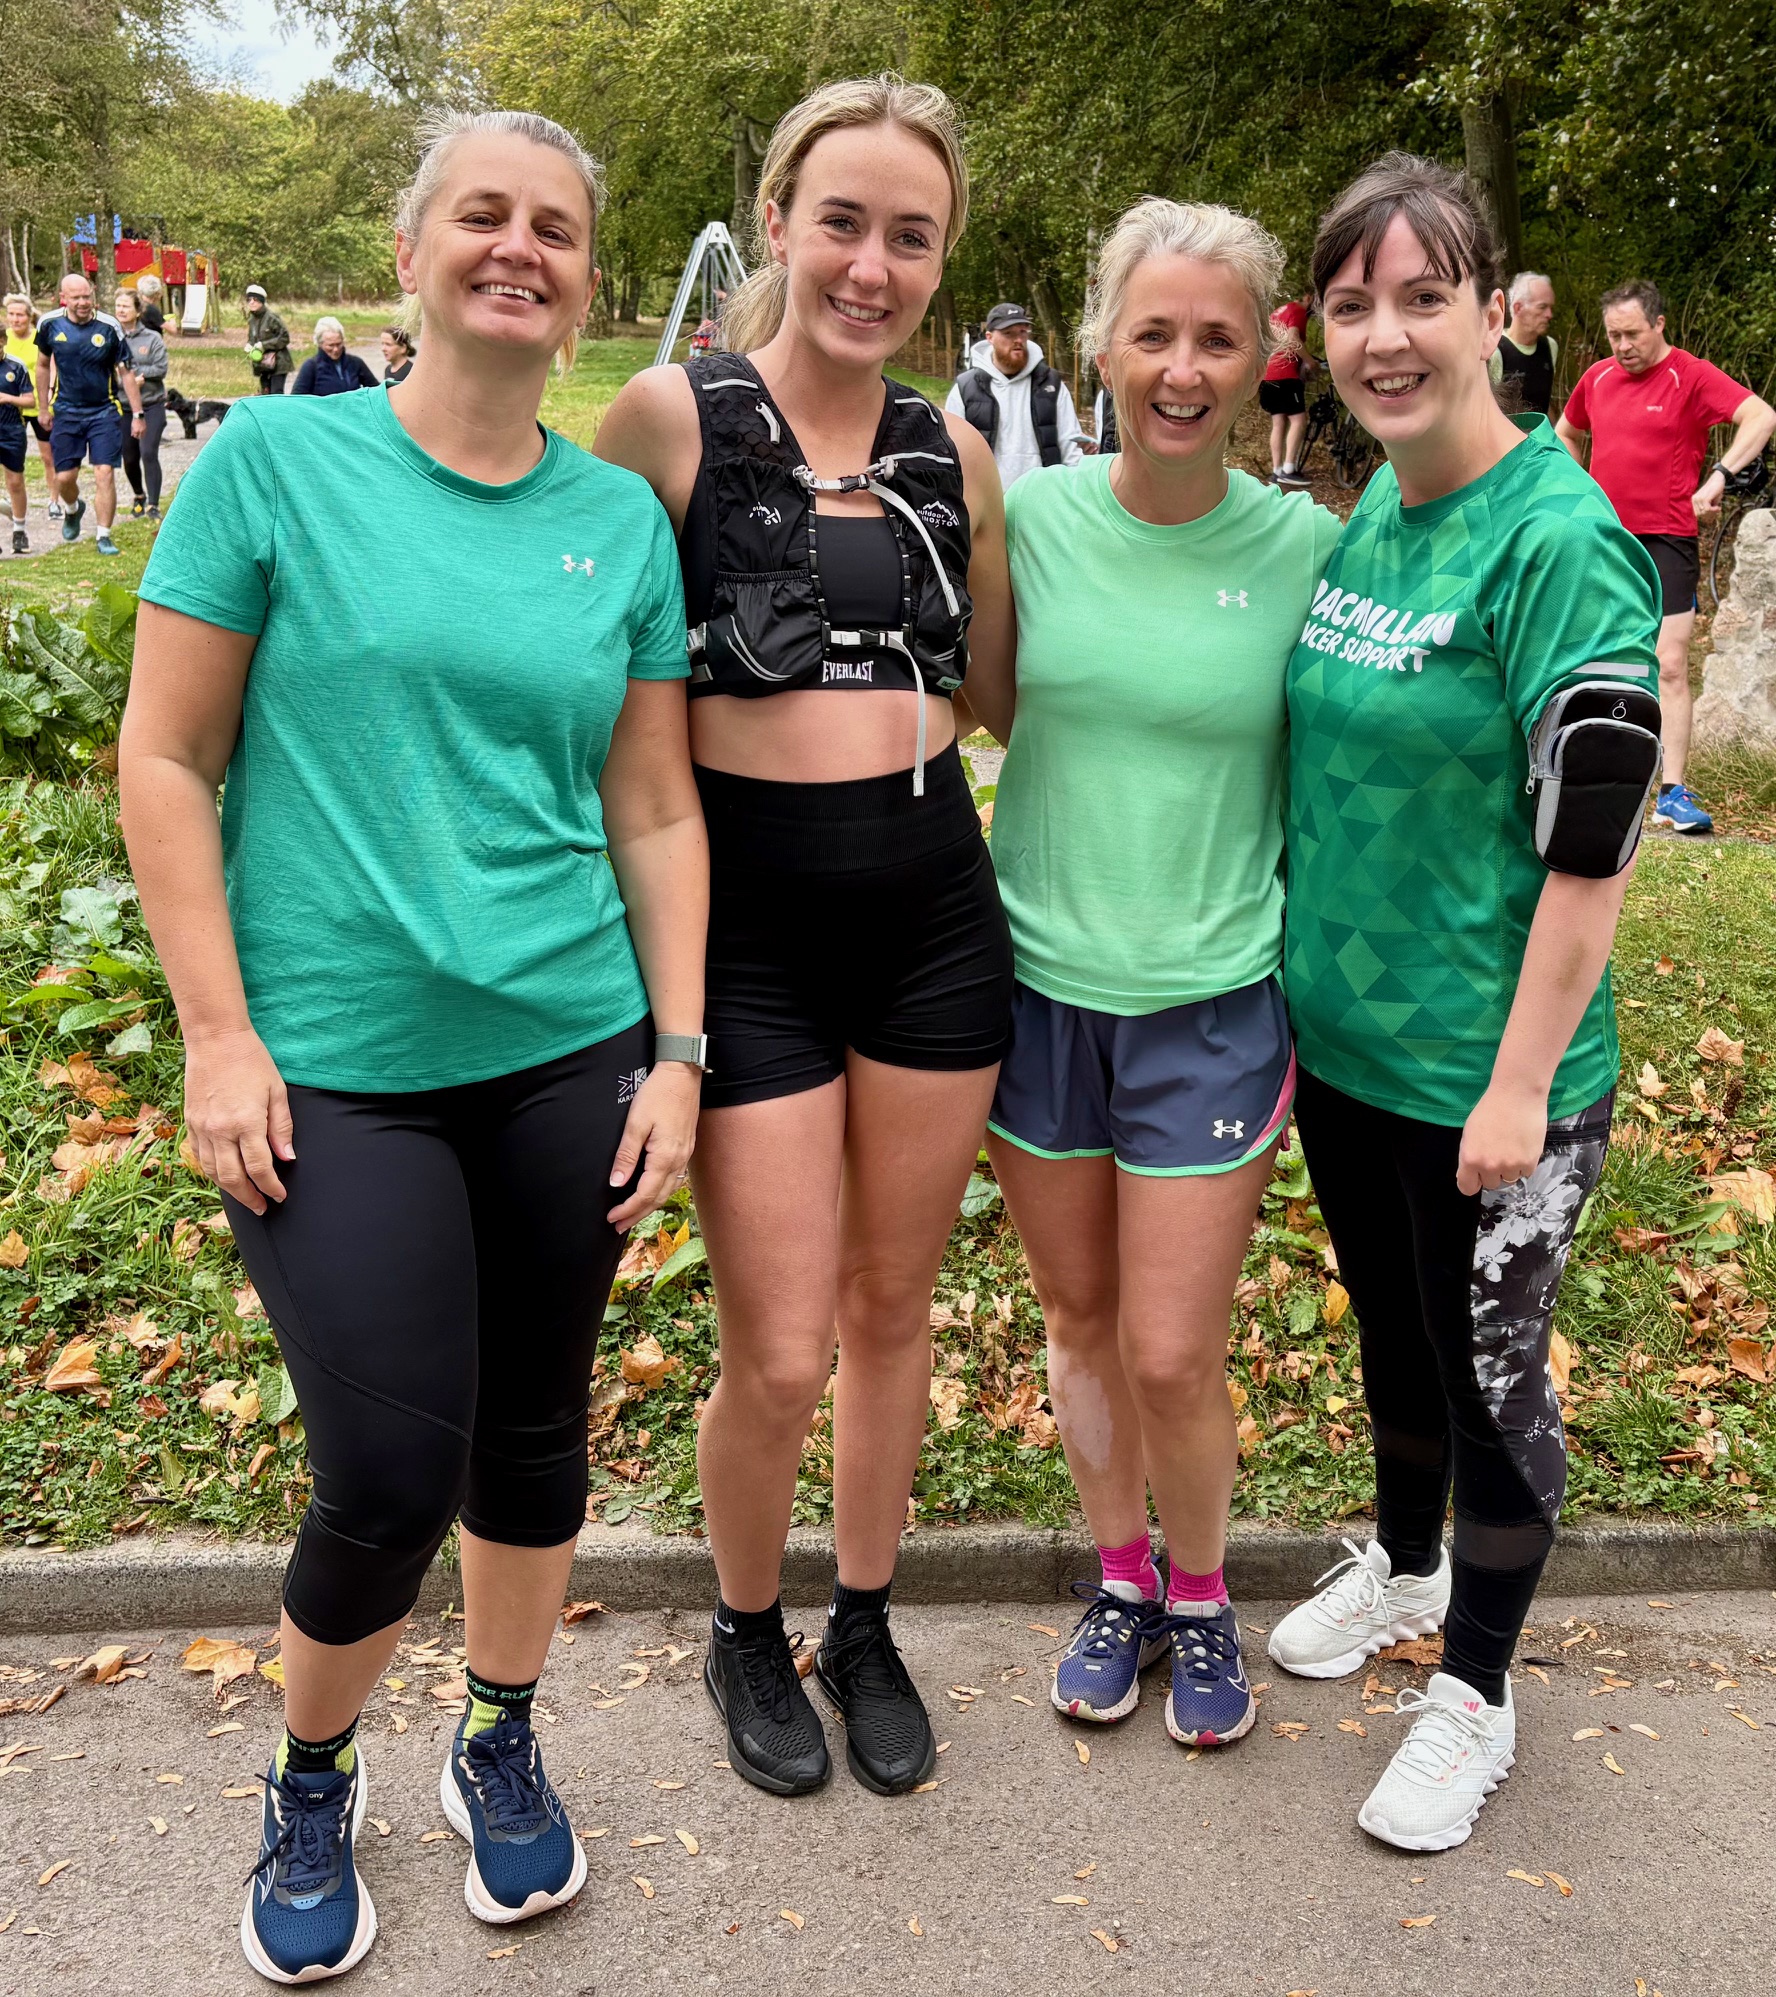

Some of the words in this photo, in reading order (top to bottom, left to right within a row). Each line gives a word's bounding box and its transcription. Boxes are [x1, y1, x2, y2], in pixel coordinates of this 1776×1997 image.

[917, 510, 945, 519] outdoor
[1299, 620, 1344, 655] NCER
[1338, 636, 1431, 673] SUPPORT
[821, 660, 874, 683] EVERLAST
